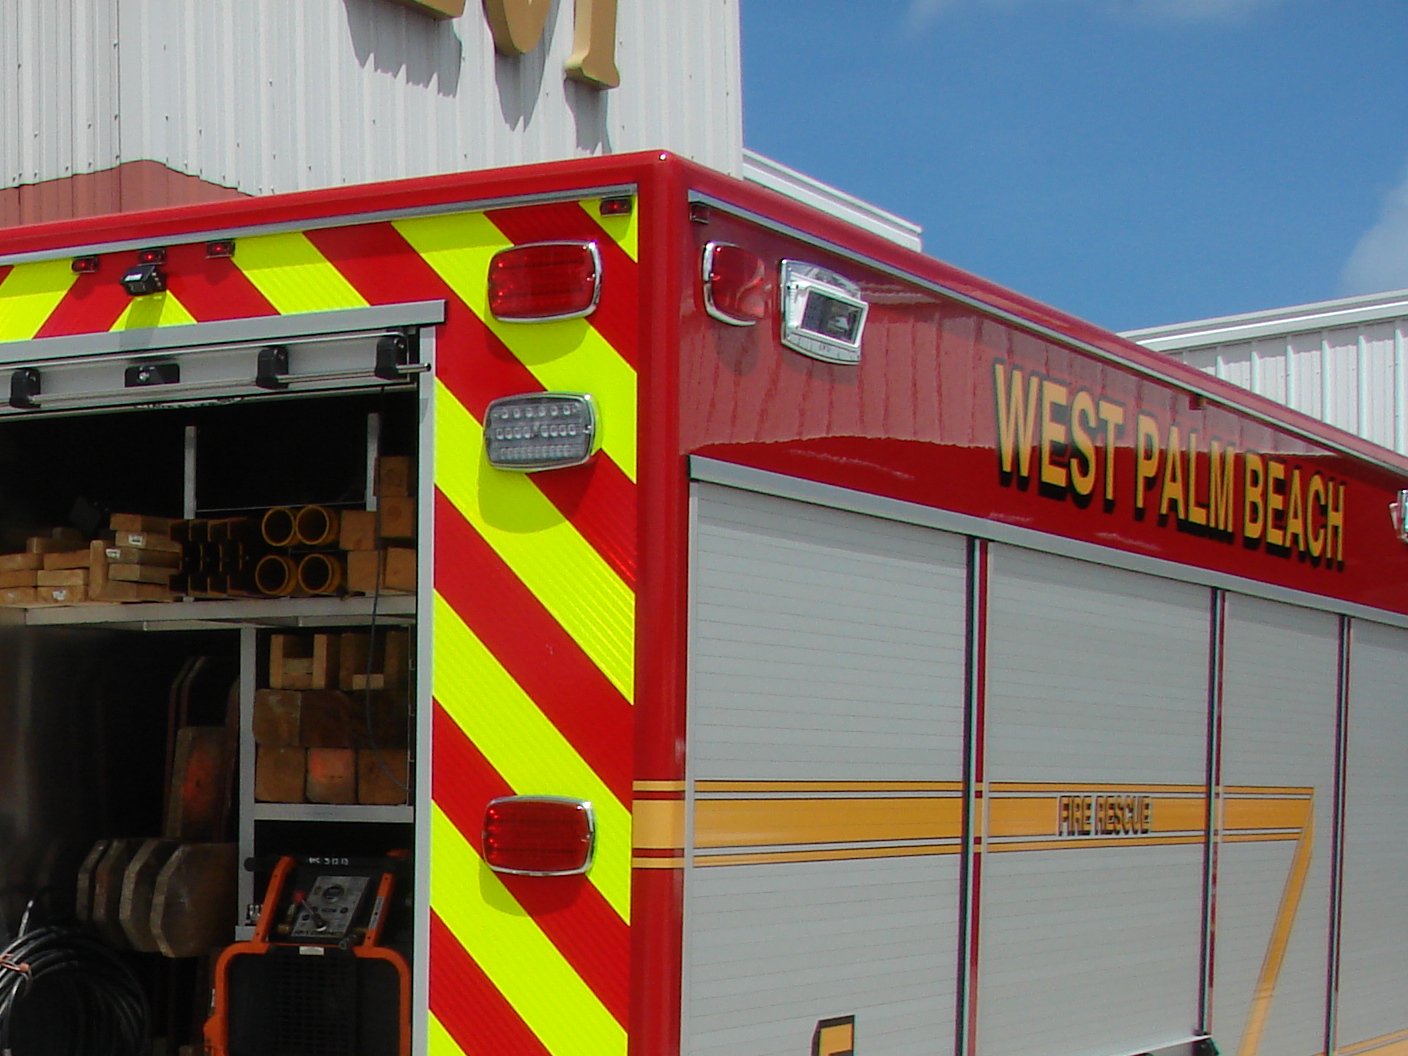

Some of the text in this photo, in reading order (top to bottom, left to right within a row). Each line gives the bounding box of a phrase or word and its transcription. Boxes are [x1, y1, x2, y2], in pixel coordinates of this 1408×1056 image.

[994, 361, 1346, 566] WEST PALM BEACH
[1058, 795, 1150, 836] FIRE RESCUE
